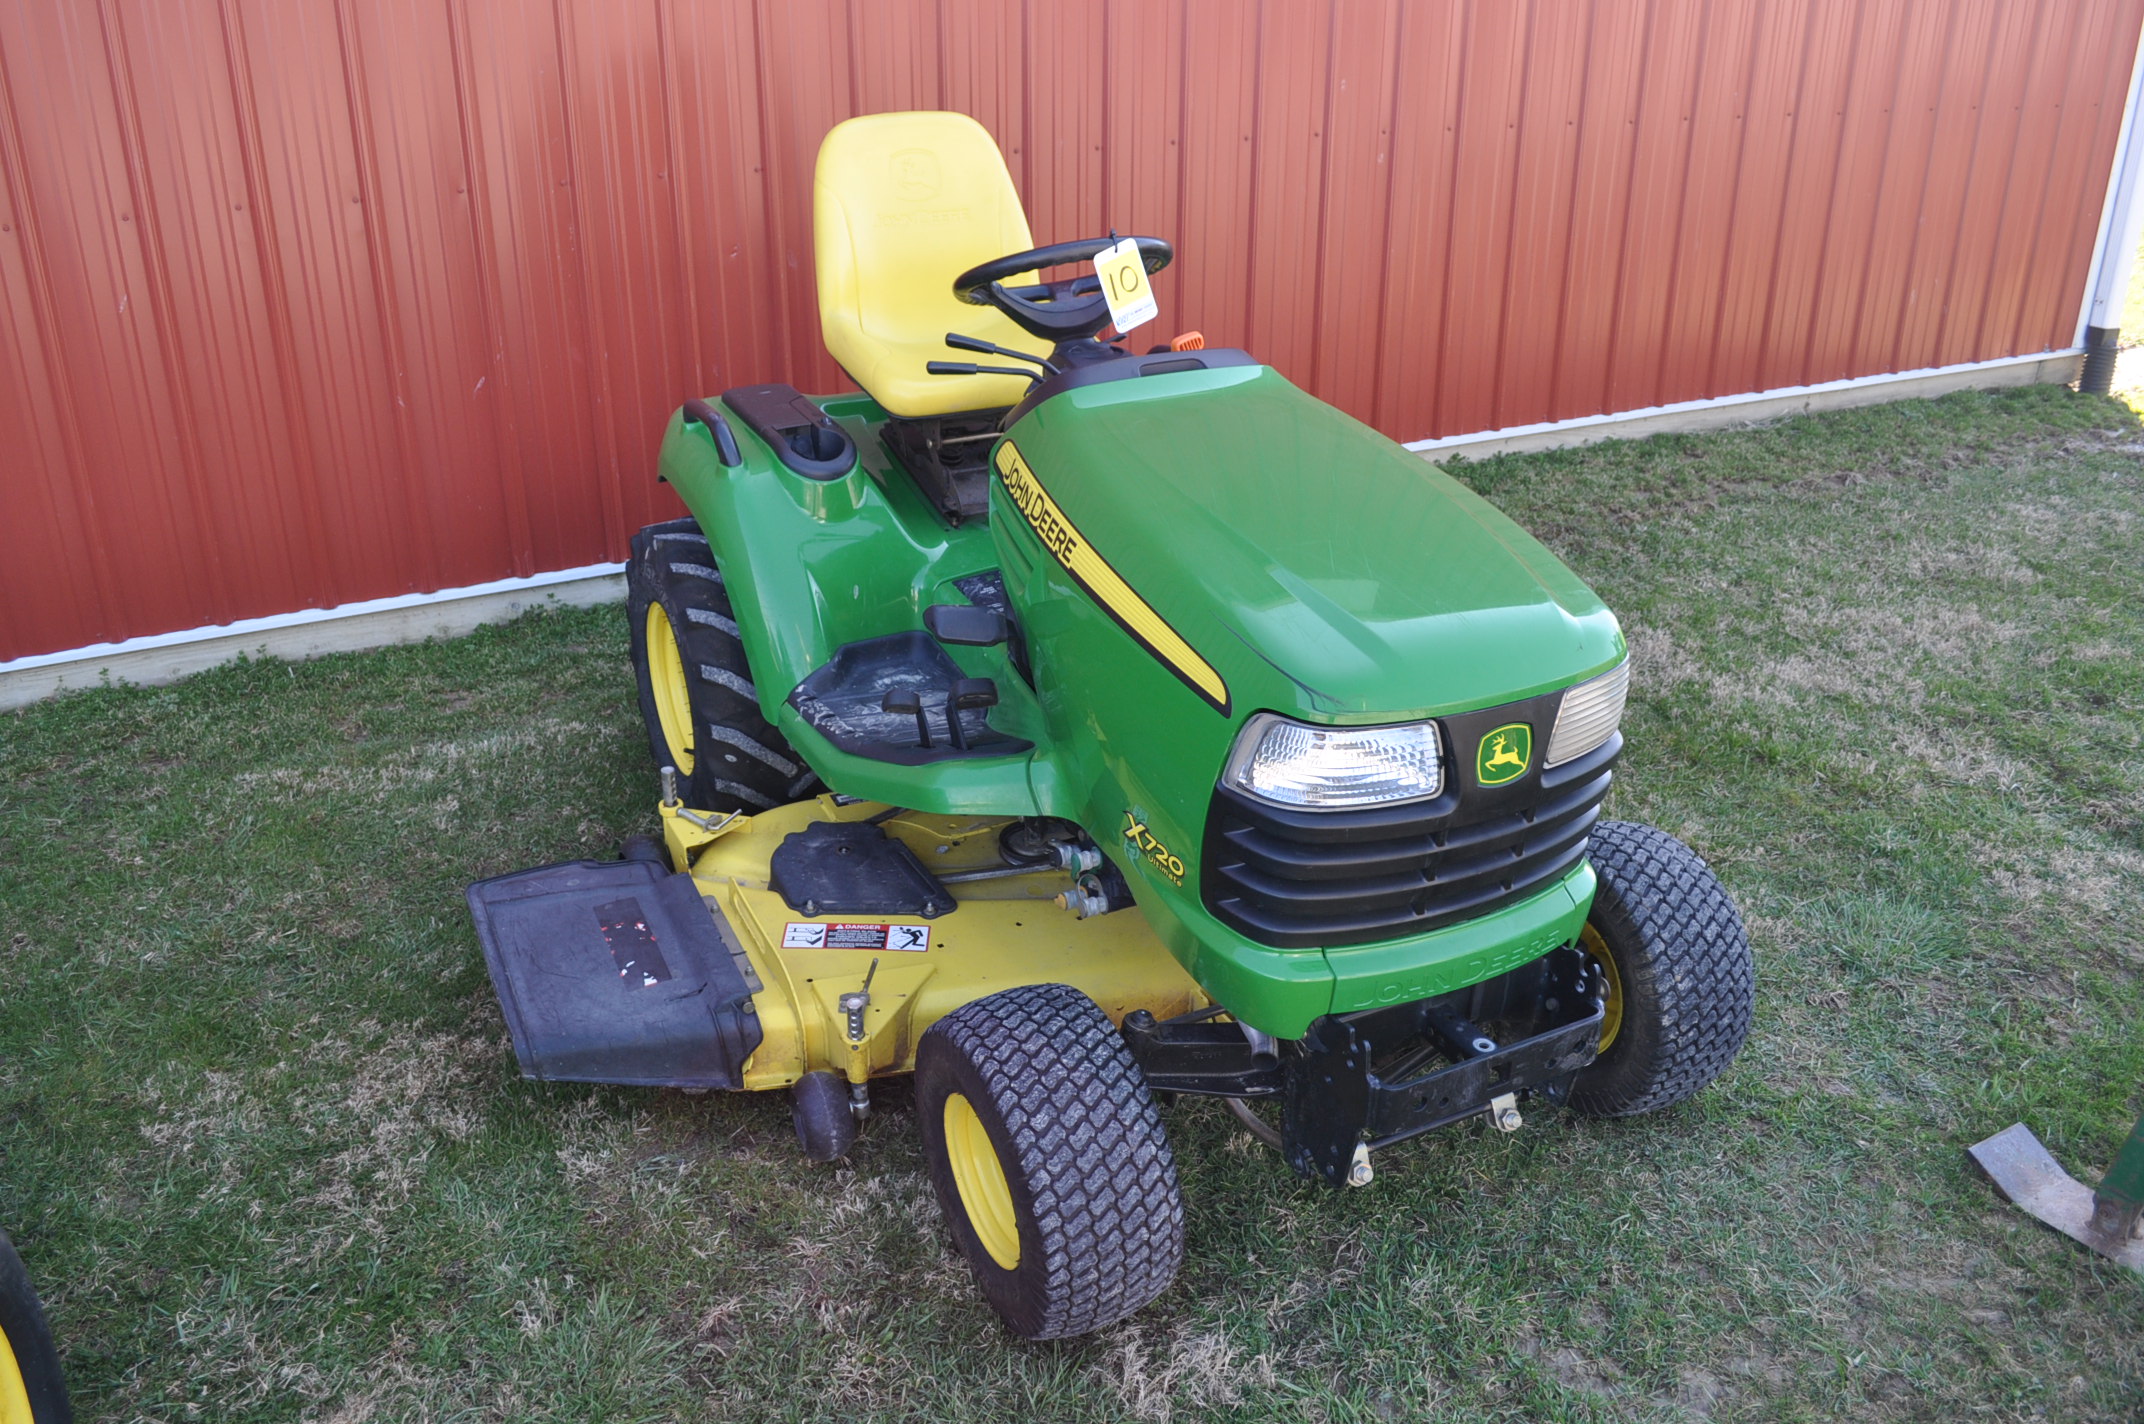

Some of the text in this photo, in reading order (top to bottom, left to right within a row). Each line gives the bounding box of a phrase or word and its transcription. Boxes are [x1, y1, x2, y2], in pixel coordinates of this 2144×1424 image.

[1109, 265, 1139, 301] 10
[1003, 458, 1078, 564] JOHN DEERE
[1122, 810, 1185, 879] X720
[1353, 929, 1561, 1008] JOHN DEERE
